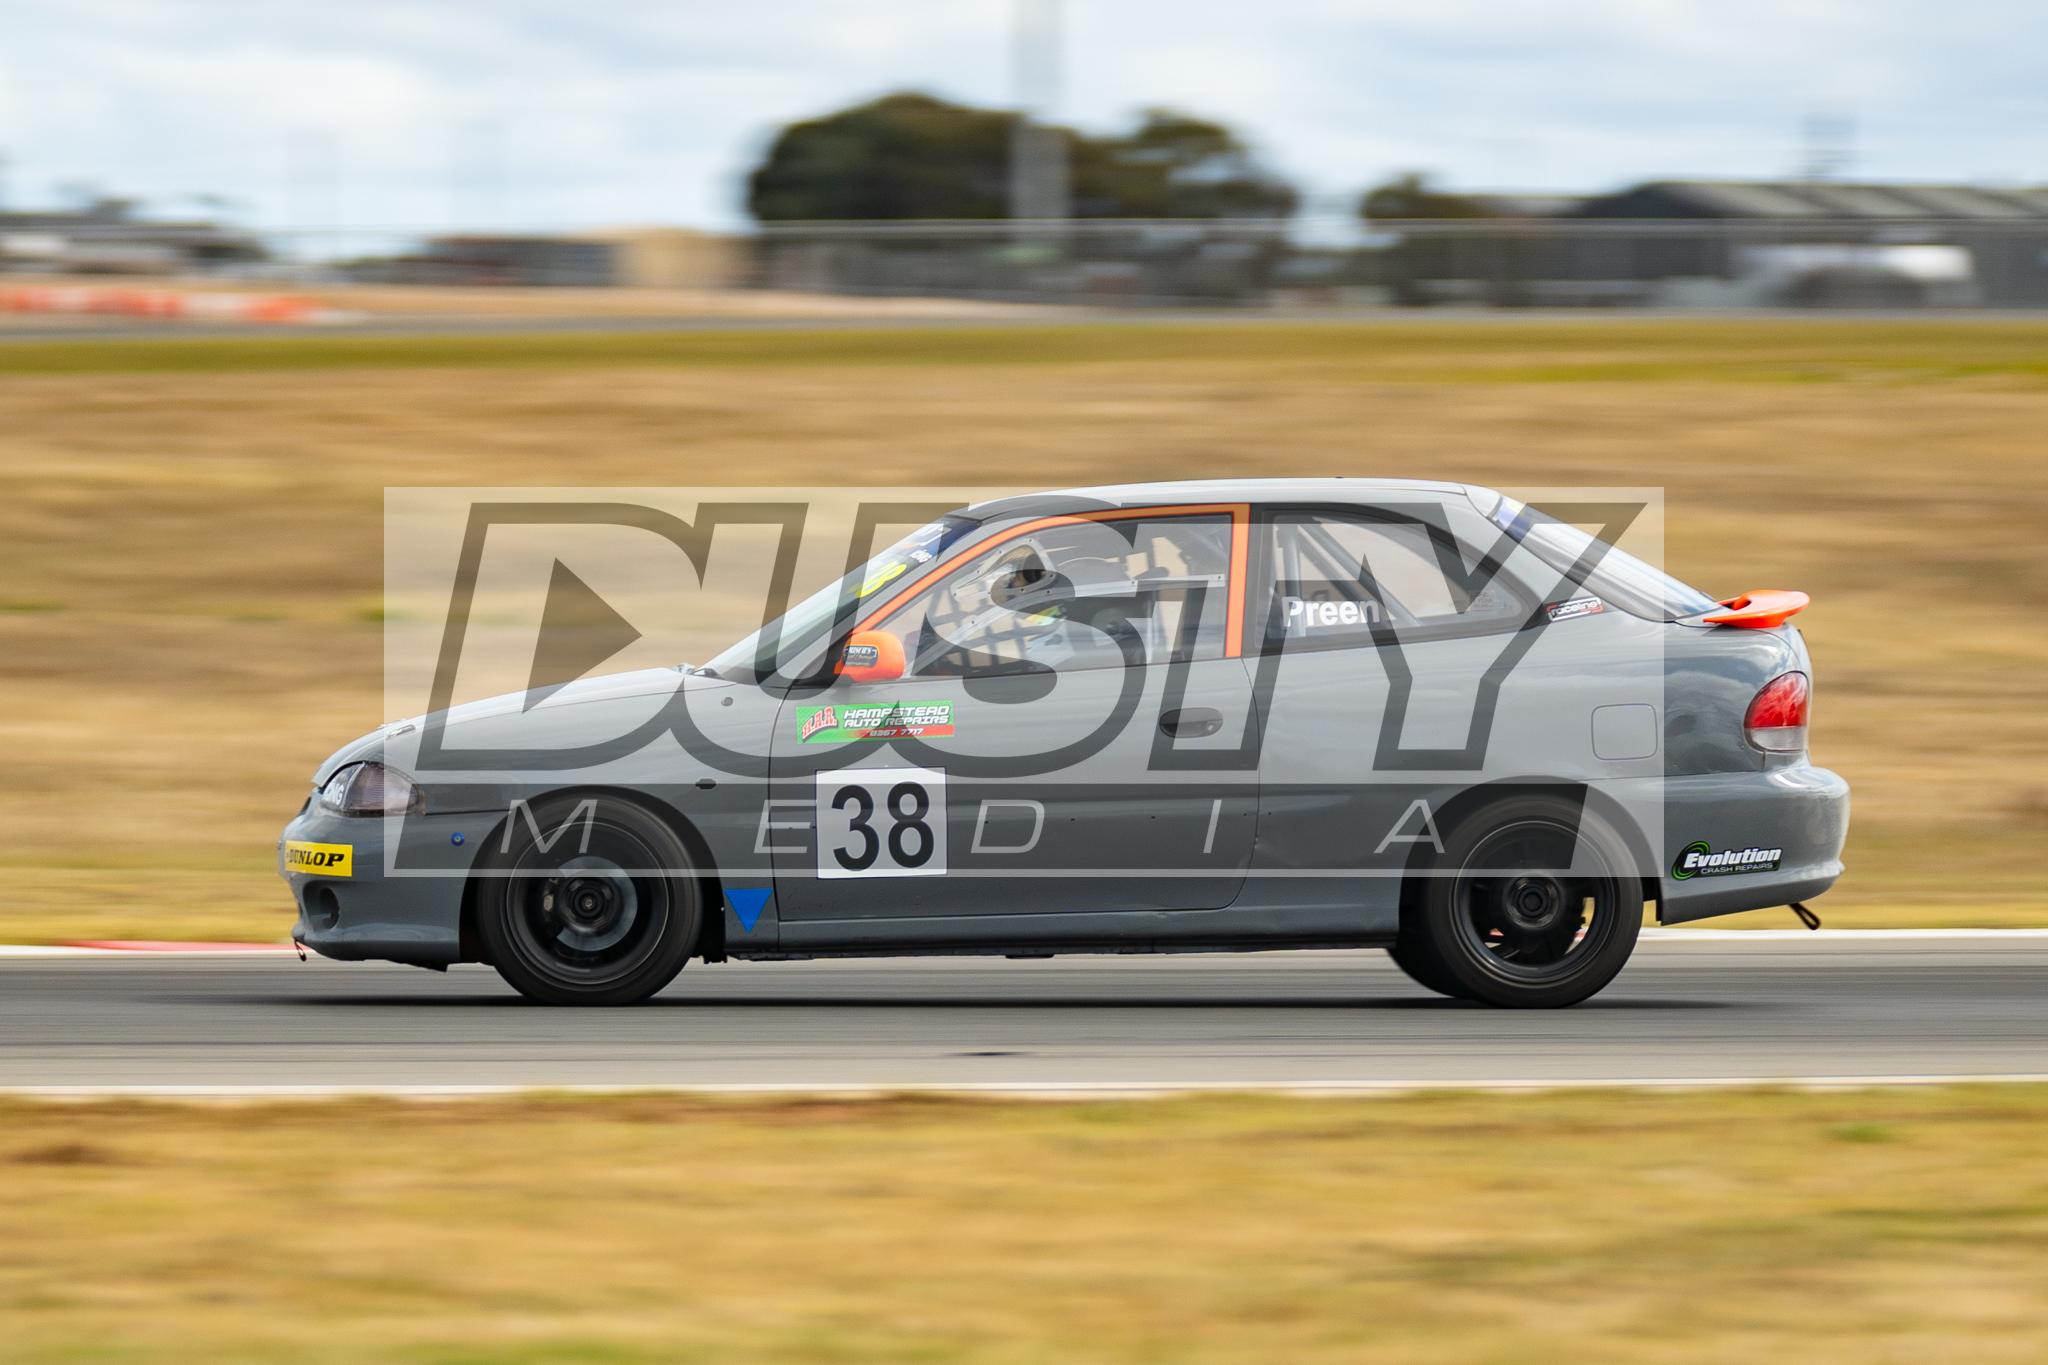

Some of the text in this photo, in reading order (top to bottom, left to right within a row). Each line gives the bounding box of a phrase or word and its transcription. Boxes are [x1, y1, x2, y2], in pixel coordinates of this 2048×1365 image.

[1281, 596, 1380, 627] Preen
[843, 705, 950, 720] HAMPSTEAD
[844, 714, 950, 728] AUTO REPAIRS
[831, 781, 935, 872] 38
[288, 848, 345, 867] DUNLOP
[1683, 848, 1782, 868] Evolution
[1701, 863, 1773, 875] CRASH REPAIRS
